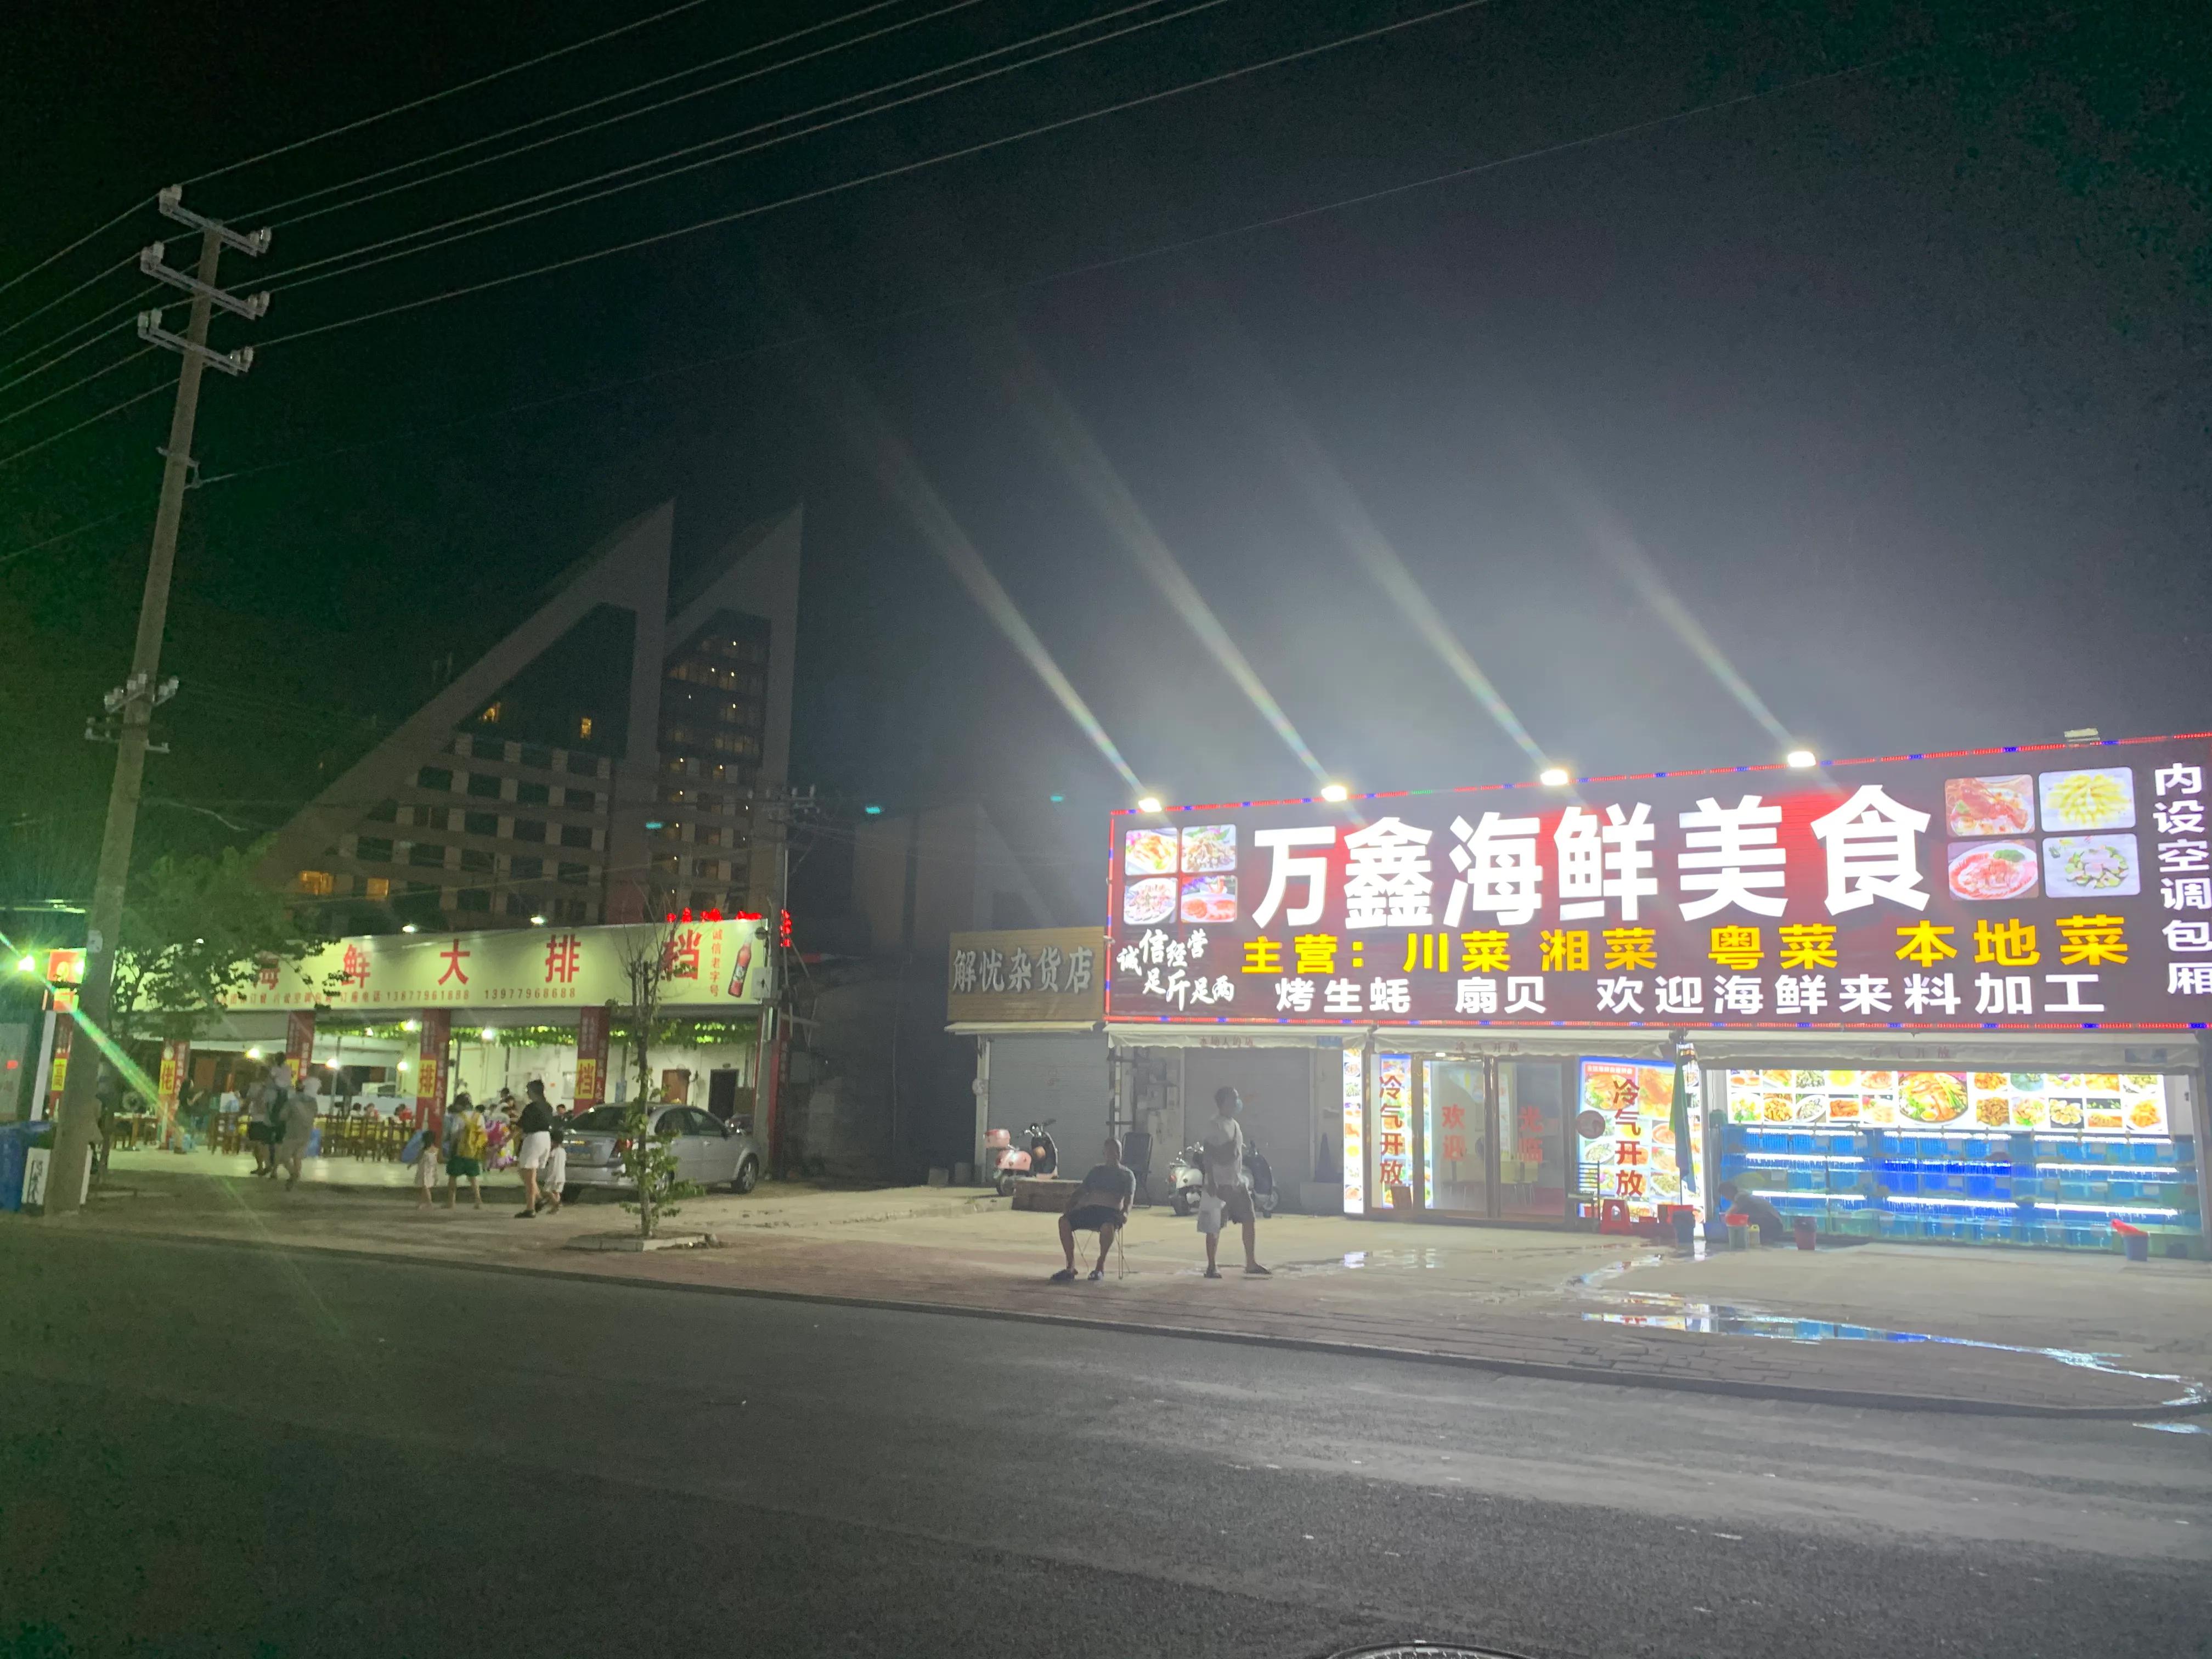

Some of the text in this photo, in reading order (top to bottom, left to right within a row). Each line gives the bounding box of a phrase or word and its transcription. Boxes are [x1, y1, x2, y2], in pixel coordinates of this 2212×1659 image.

[1251, 784, 1931, 930] 万鑫海鲜美食
[2152, 762, 2212, 995] 内设空调包厢
[953, 945, 1093, 994] 解忧杂货店
[1276, 973, 2105, 1014] 烤生蚝 扇贝 欢迎海鲜来料加工
[1403, 930, 1511, 973] 川菜
[1539, 927, 1658, 972] 湘菜
[1708, 924, 1838, 970] 粤菜
[1895, 914, 2129, 968] 本地菜
[1379, 1075, 1404, 1184] 冷气开放
[1613, 1079, 1643, 1197] 冷气开放
